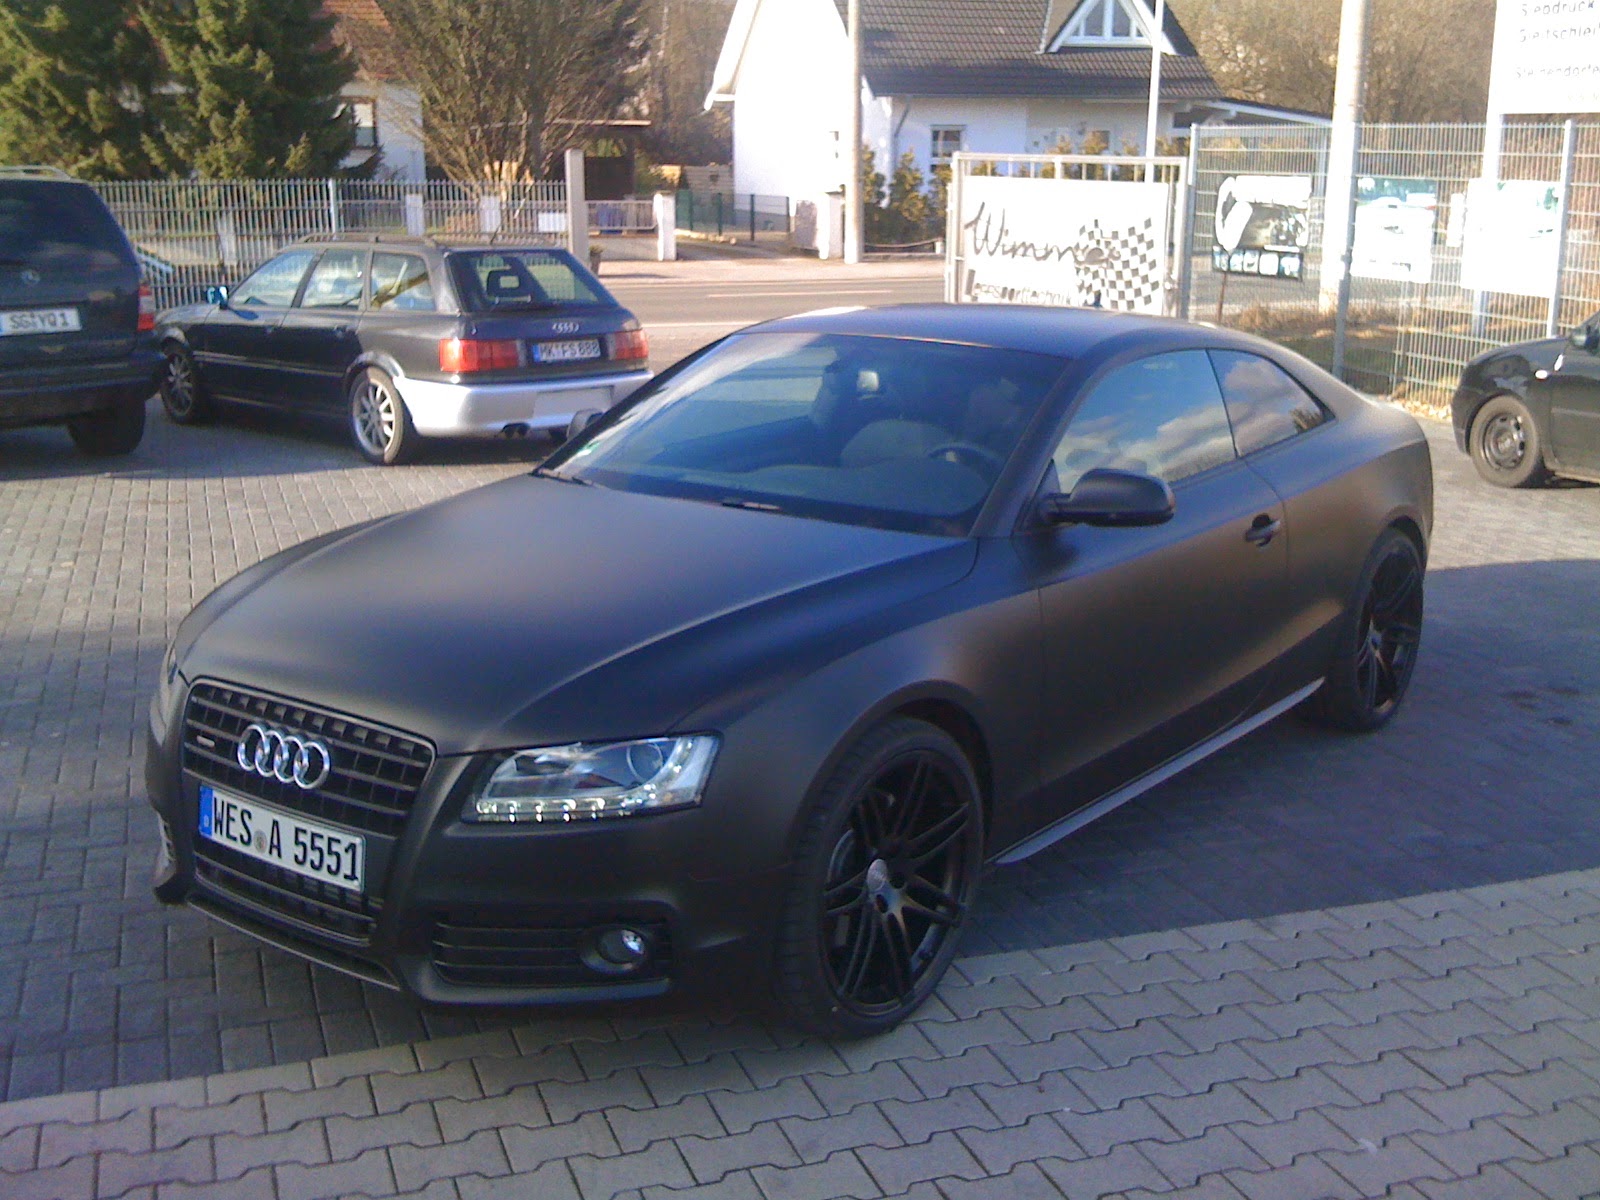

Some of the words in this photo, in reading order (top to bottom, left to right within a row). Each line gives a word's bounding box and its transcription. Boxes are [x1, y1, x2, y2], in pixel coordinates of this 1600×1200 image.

[213, 796, 253, 847] WES
[268, 818, 283, 860] A
[293, 825, 360, 882] 5551
